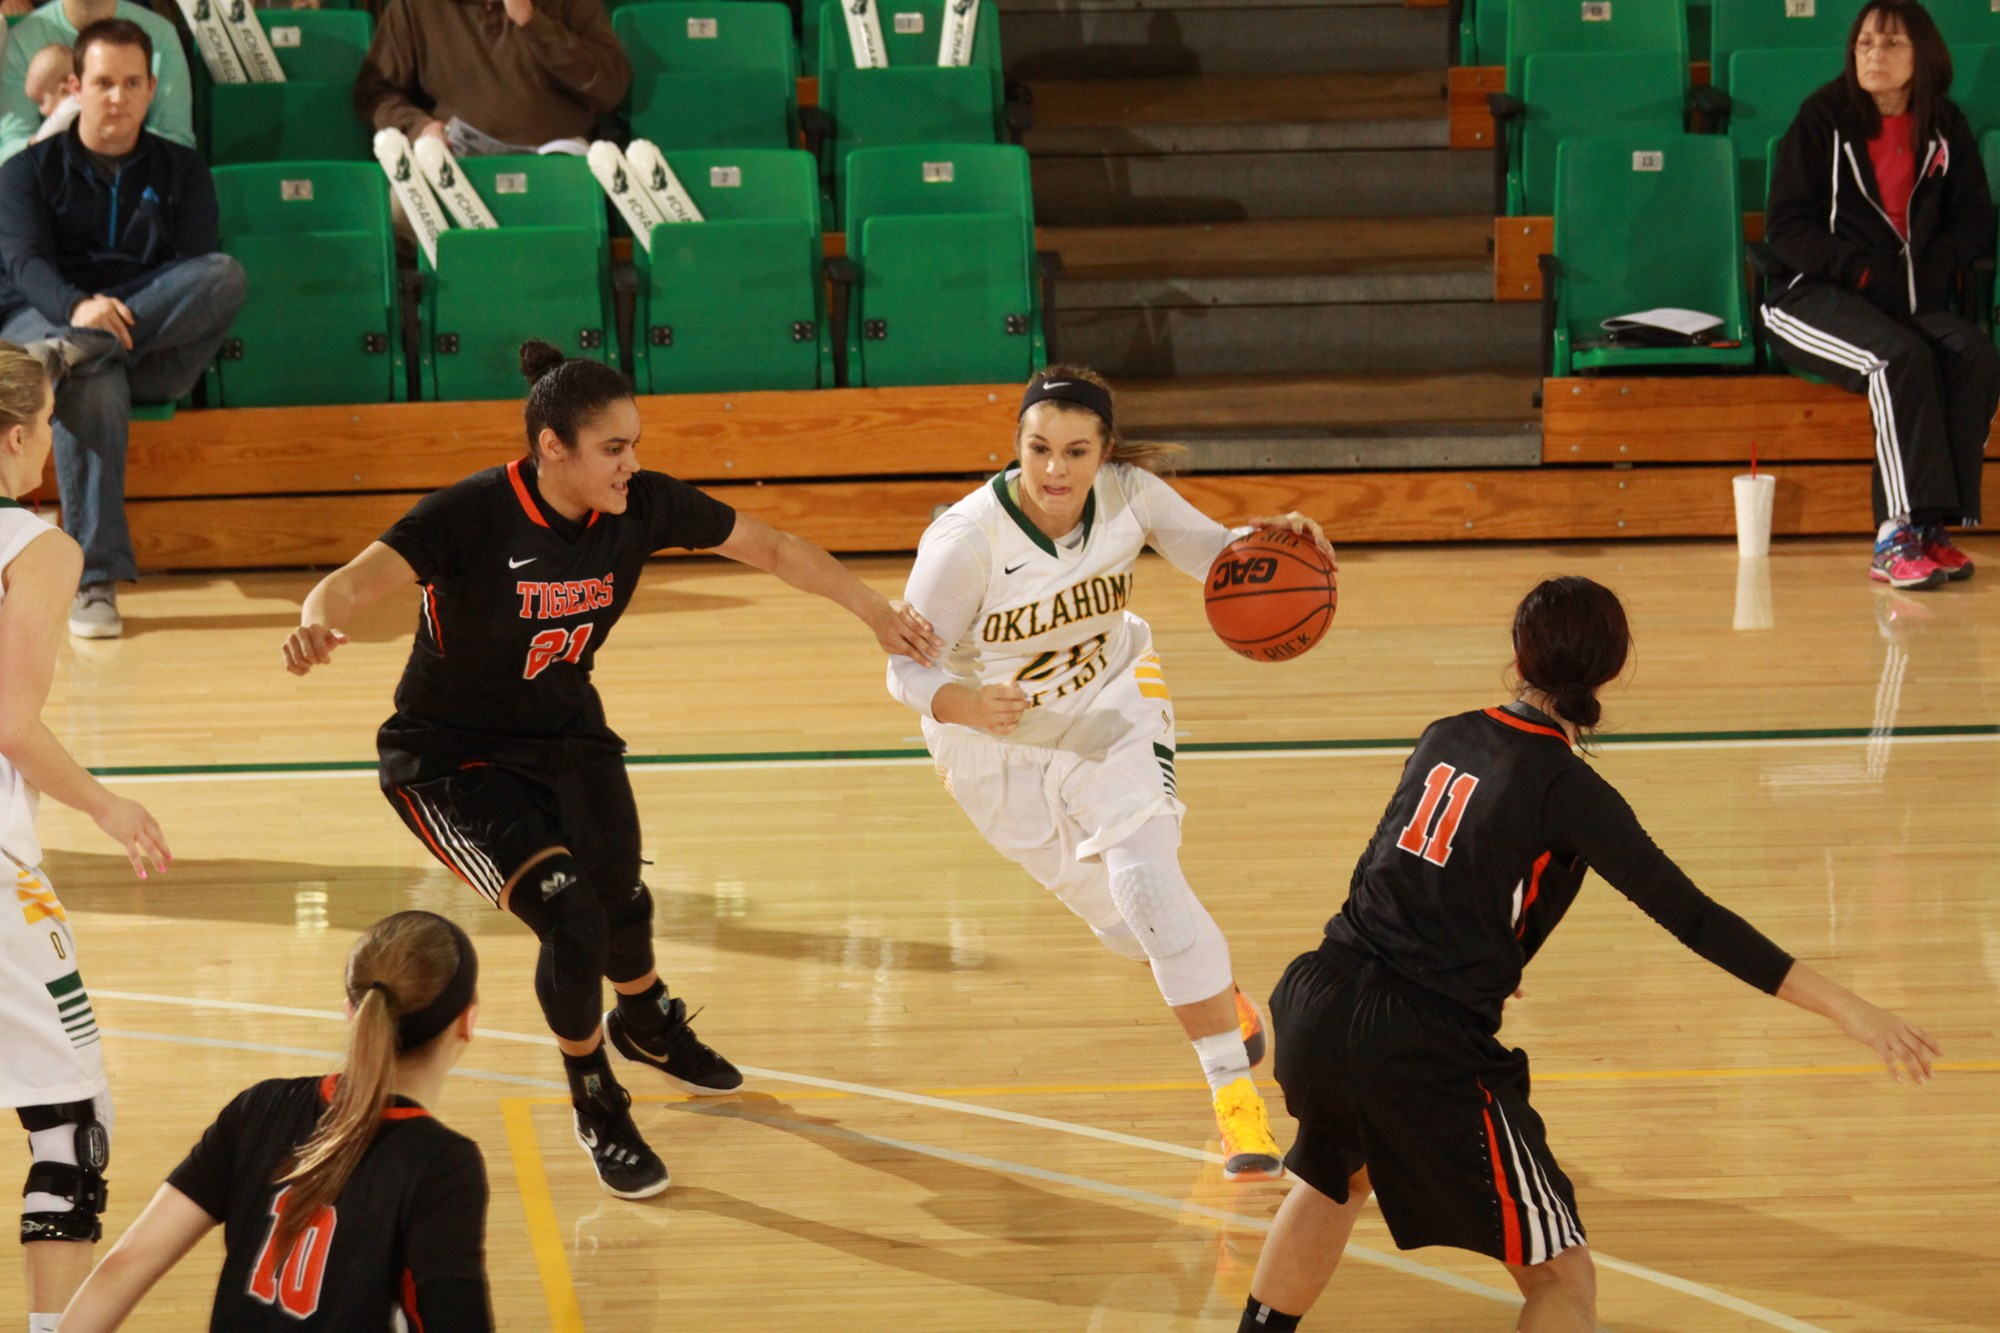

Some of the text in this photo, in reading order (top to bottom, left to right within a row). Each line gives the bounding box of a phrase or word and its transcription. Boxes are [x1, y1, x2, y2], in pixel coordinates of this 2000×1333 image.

[516, 572, 614, 619] TIGERS
[1212, 557, 1279, 592] GAC
[523, 622, 594, 680] 21
[1396, 761, 1480, 868] 11
[247, 1184, 338, 1320] 10
